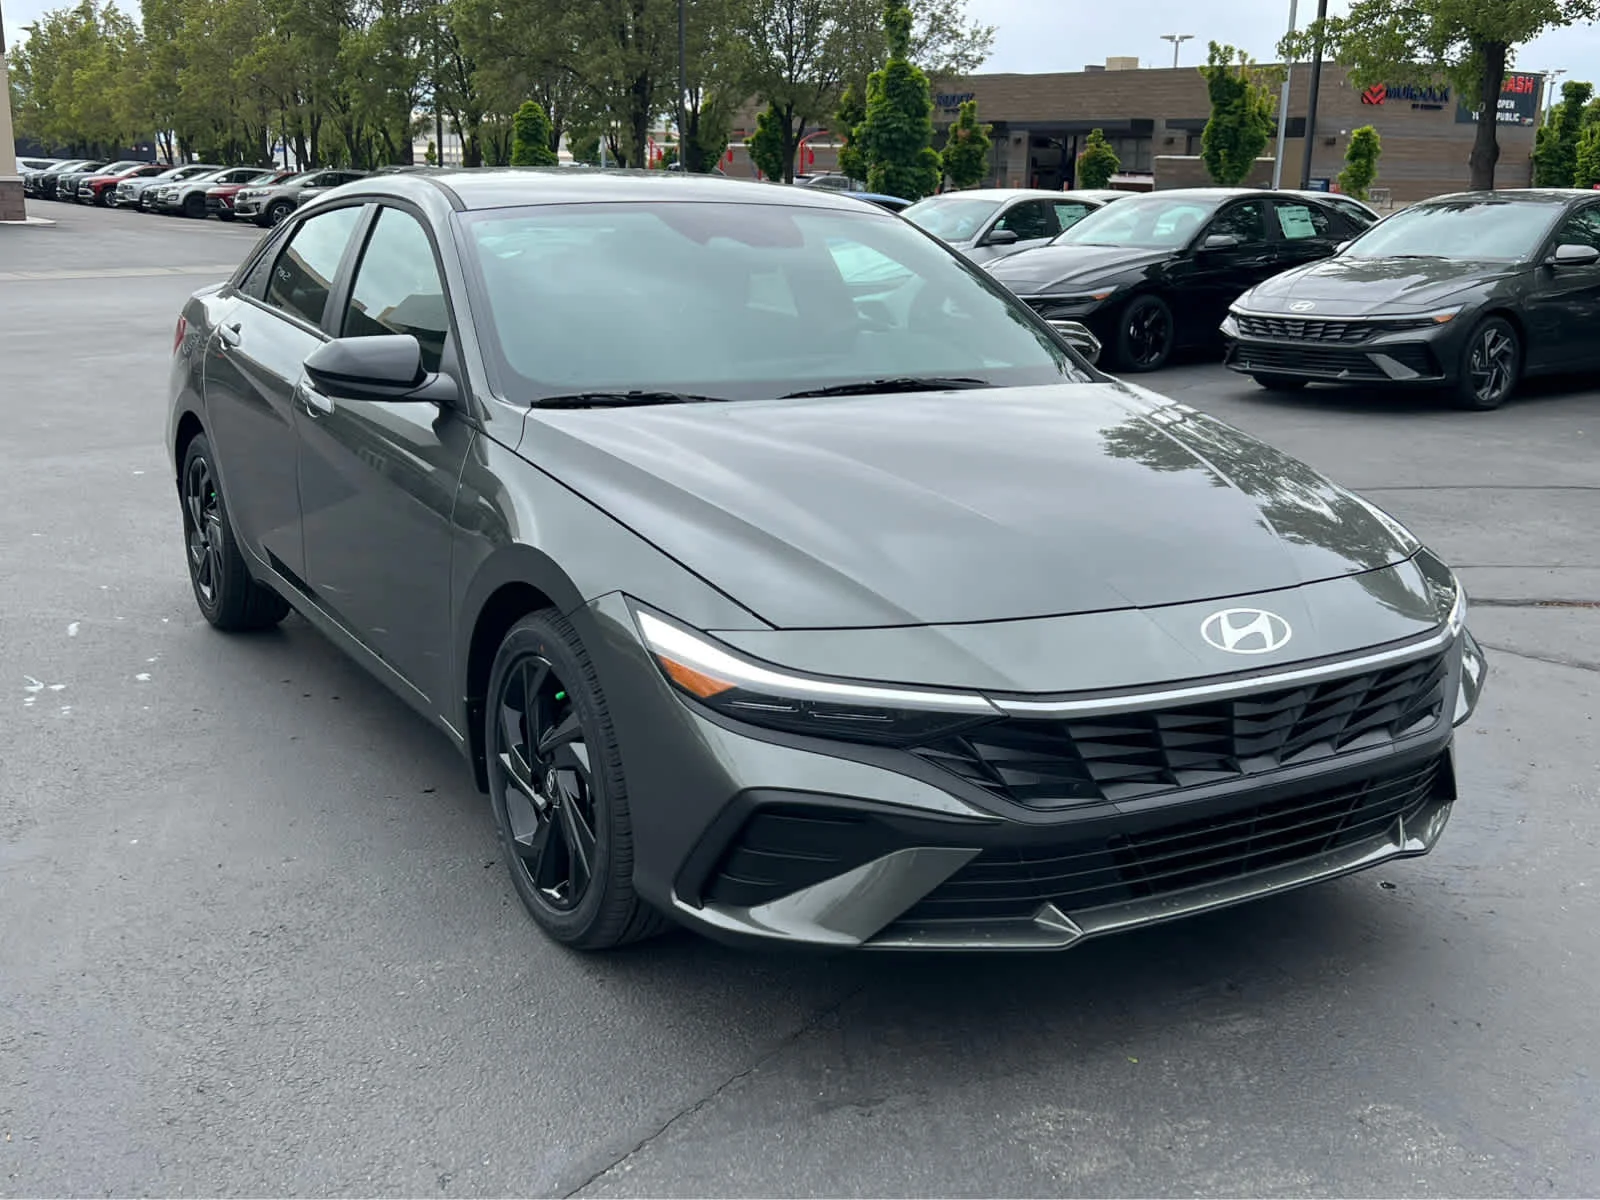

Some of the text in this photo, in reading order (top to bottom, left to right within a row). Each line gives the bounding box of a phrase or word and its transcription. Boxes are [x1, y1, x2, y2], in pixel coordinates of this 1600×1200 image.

[1502, 75, 1535, 94] ASH
[1496, 99, 1515, 109] OPEN
[1496, 111, 1520, 122] PUBLIC
